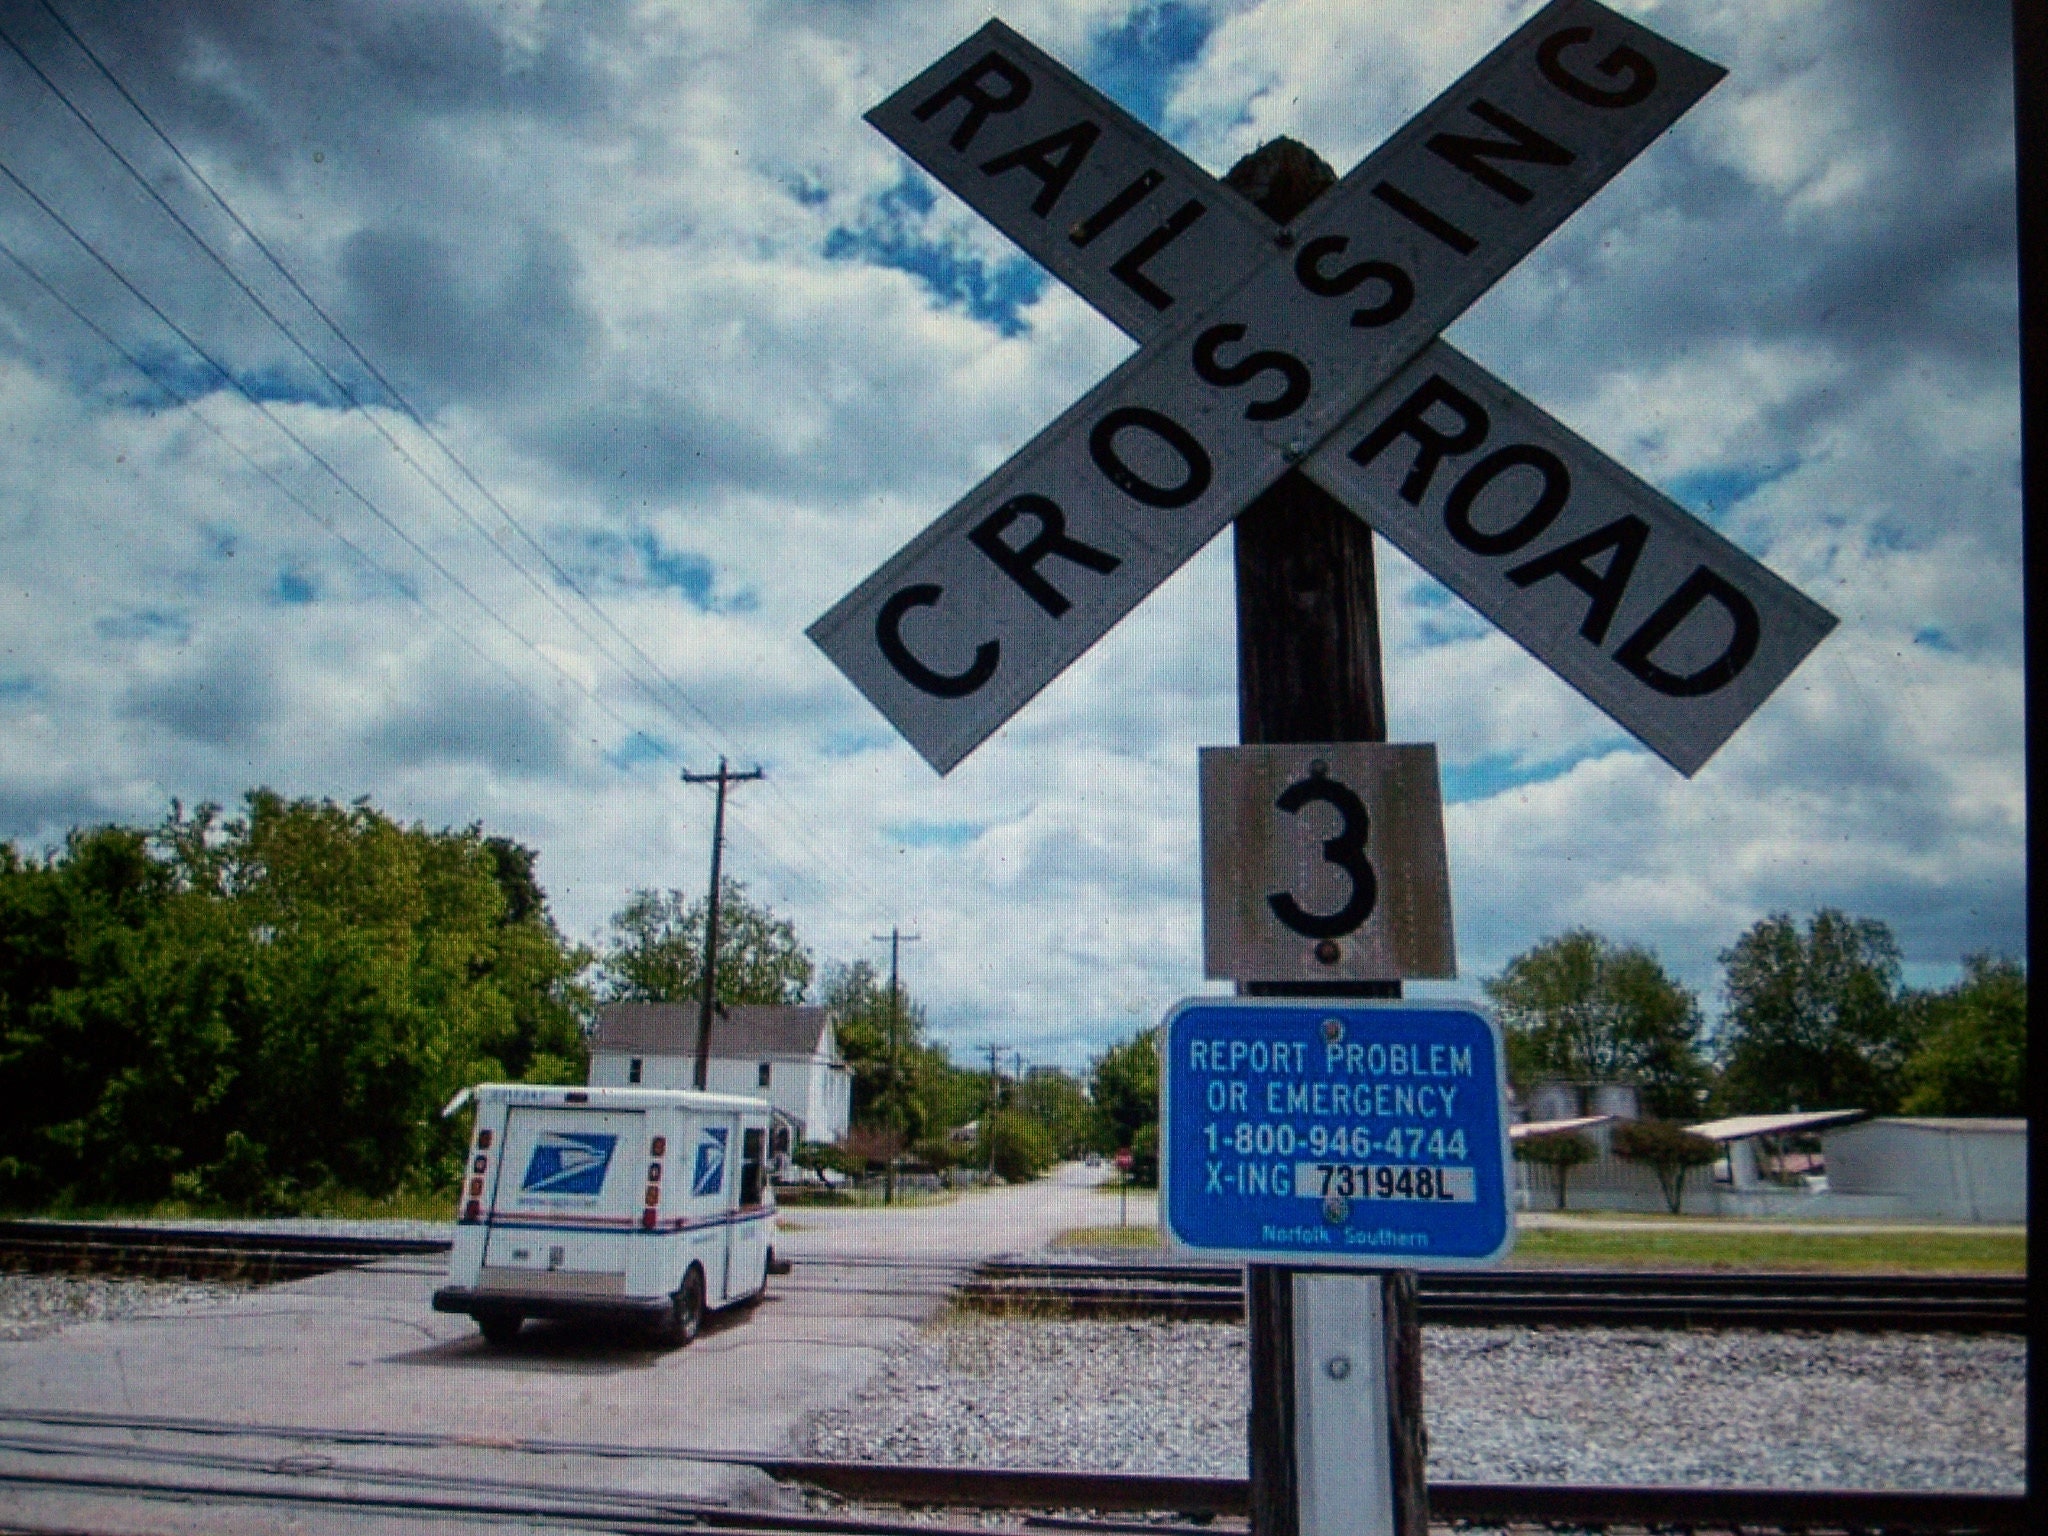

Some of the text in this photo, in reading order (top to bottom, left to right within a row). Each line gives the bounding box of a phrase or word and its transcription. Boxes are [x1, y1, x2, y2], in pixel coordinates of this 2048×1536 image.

[913, 50, 1206, 310] RAIL
[875, 24, 1658, 700] CROSSING
[1350, 374, 1761, 698] ROAD
[1267, 777, 1376, 939] 3
[1190, 1039, 1472, 1077] REPORT PROBLEM
[1208, 1080, 1459, 1118] OR EMERGENCY
[1203, 1122, 1469, 1160] 1-800-946-4744
[1205, 1160, 1455, 1201] X-ING 731948L
[1262, 1225, 1429, 1247] Norfolk Southern
